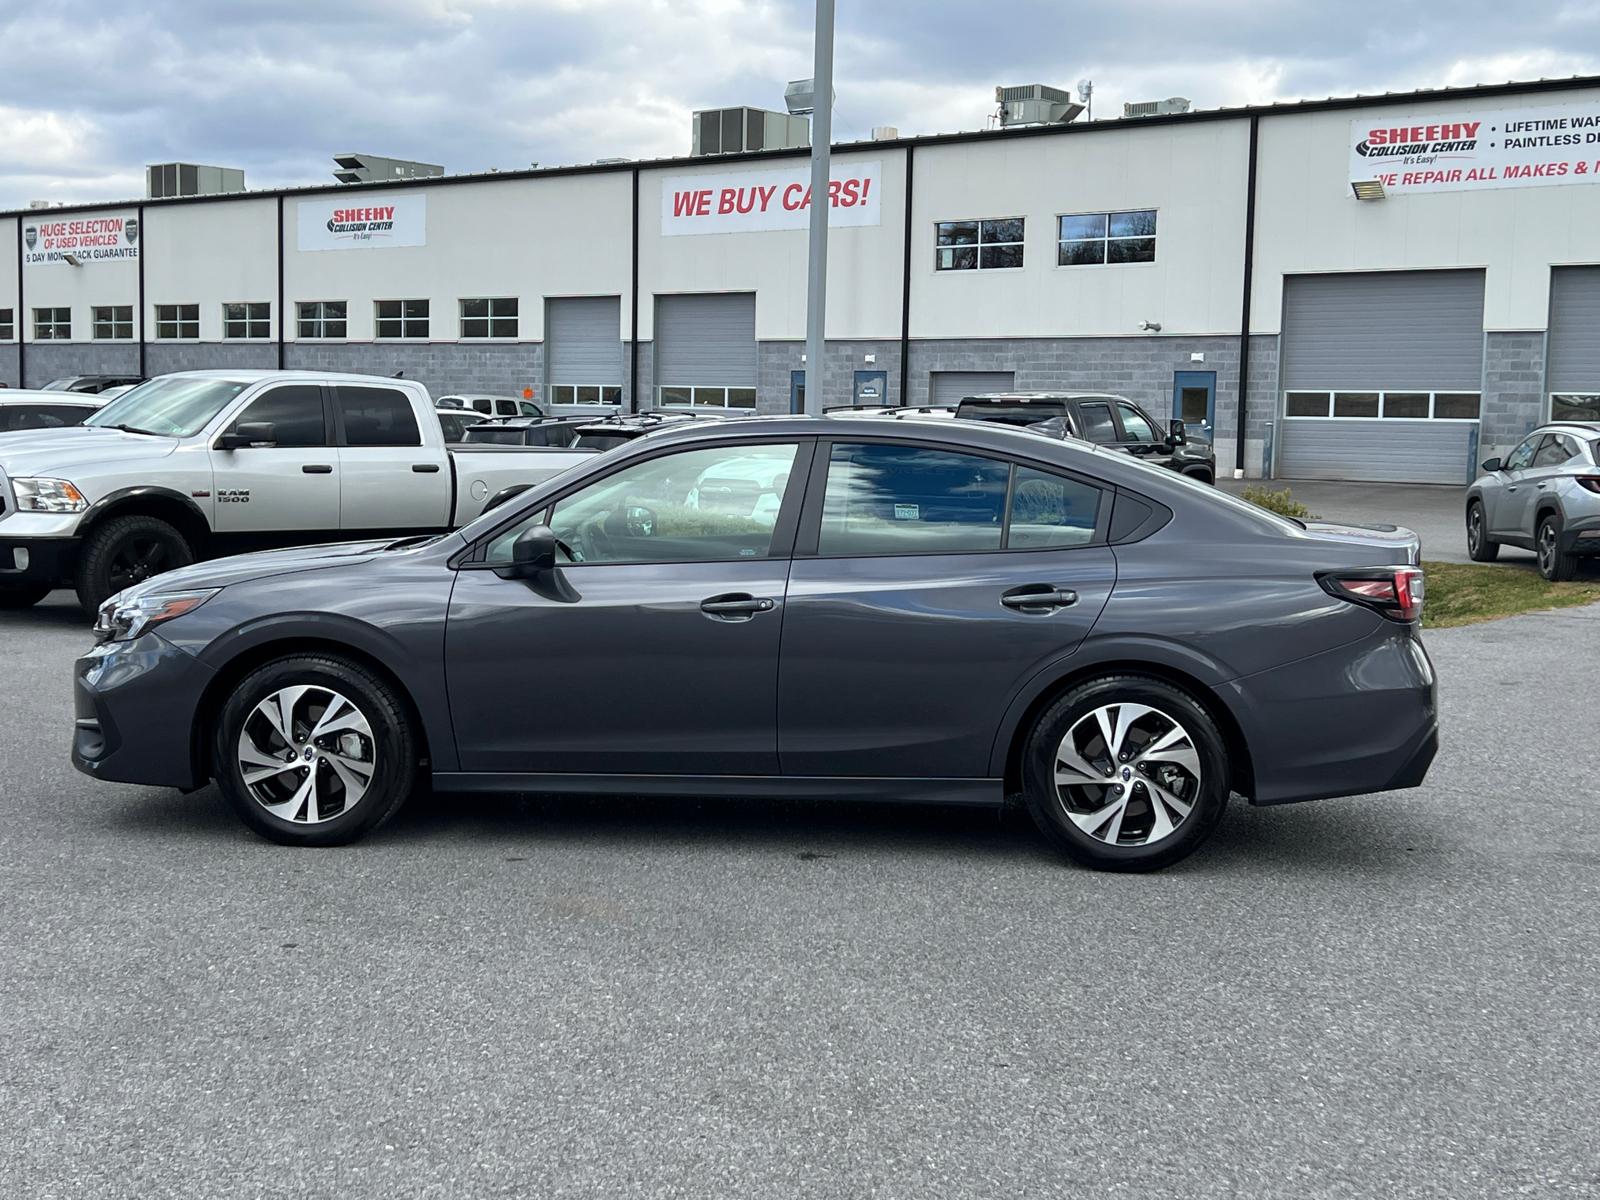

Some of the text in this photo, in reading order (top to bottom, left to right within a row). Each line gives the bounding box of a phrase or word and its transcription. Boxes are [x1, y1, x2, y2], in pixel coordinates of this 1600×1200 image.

[1369, 122, 1481, 145] SHEEHY
[1505, 118, 1567, 133] LIFETIME
[1368, 140, 1477, 157] COLLISION CENTER
[1504, 133, 1581, 149] PAINTLESS
[1403, 154, 1438, 165] It's Easy!
[1402, 169, 1462, 185] REPAIR
[1465, 167, 1497, 182] ALL
[1503, 162, 1569, 179] MAKES
[1574, 161, 1588, 174] &
[673, 190, 713, 217] WE
[718, 185, 777, 215] BUY
[333, 206, 395, 223] SHEEHY
[40, 223, 67, 237] HUGE
[69, 219, 123, 235] SELECTION
[333, 221, 393, 233] COLLISION CENTER
[44, 238, 55, 249] OF
[56, 236, 78, 249] USED
[79, 234, 118, 247] VEHICLES
[26, 254, 31, 263] 5
[32, 253, 46, 262] DAY
[93, 248, 138, 258] GUARANTEE
